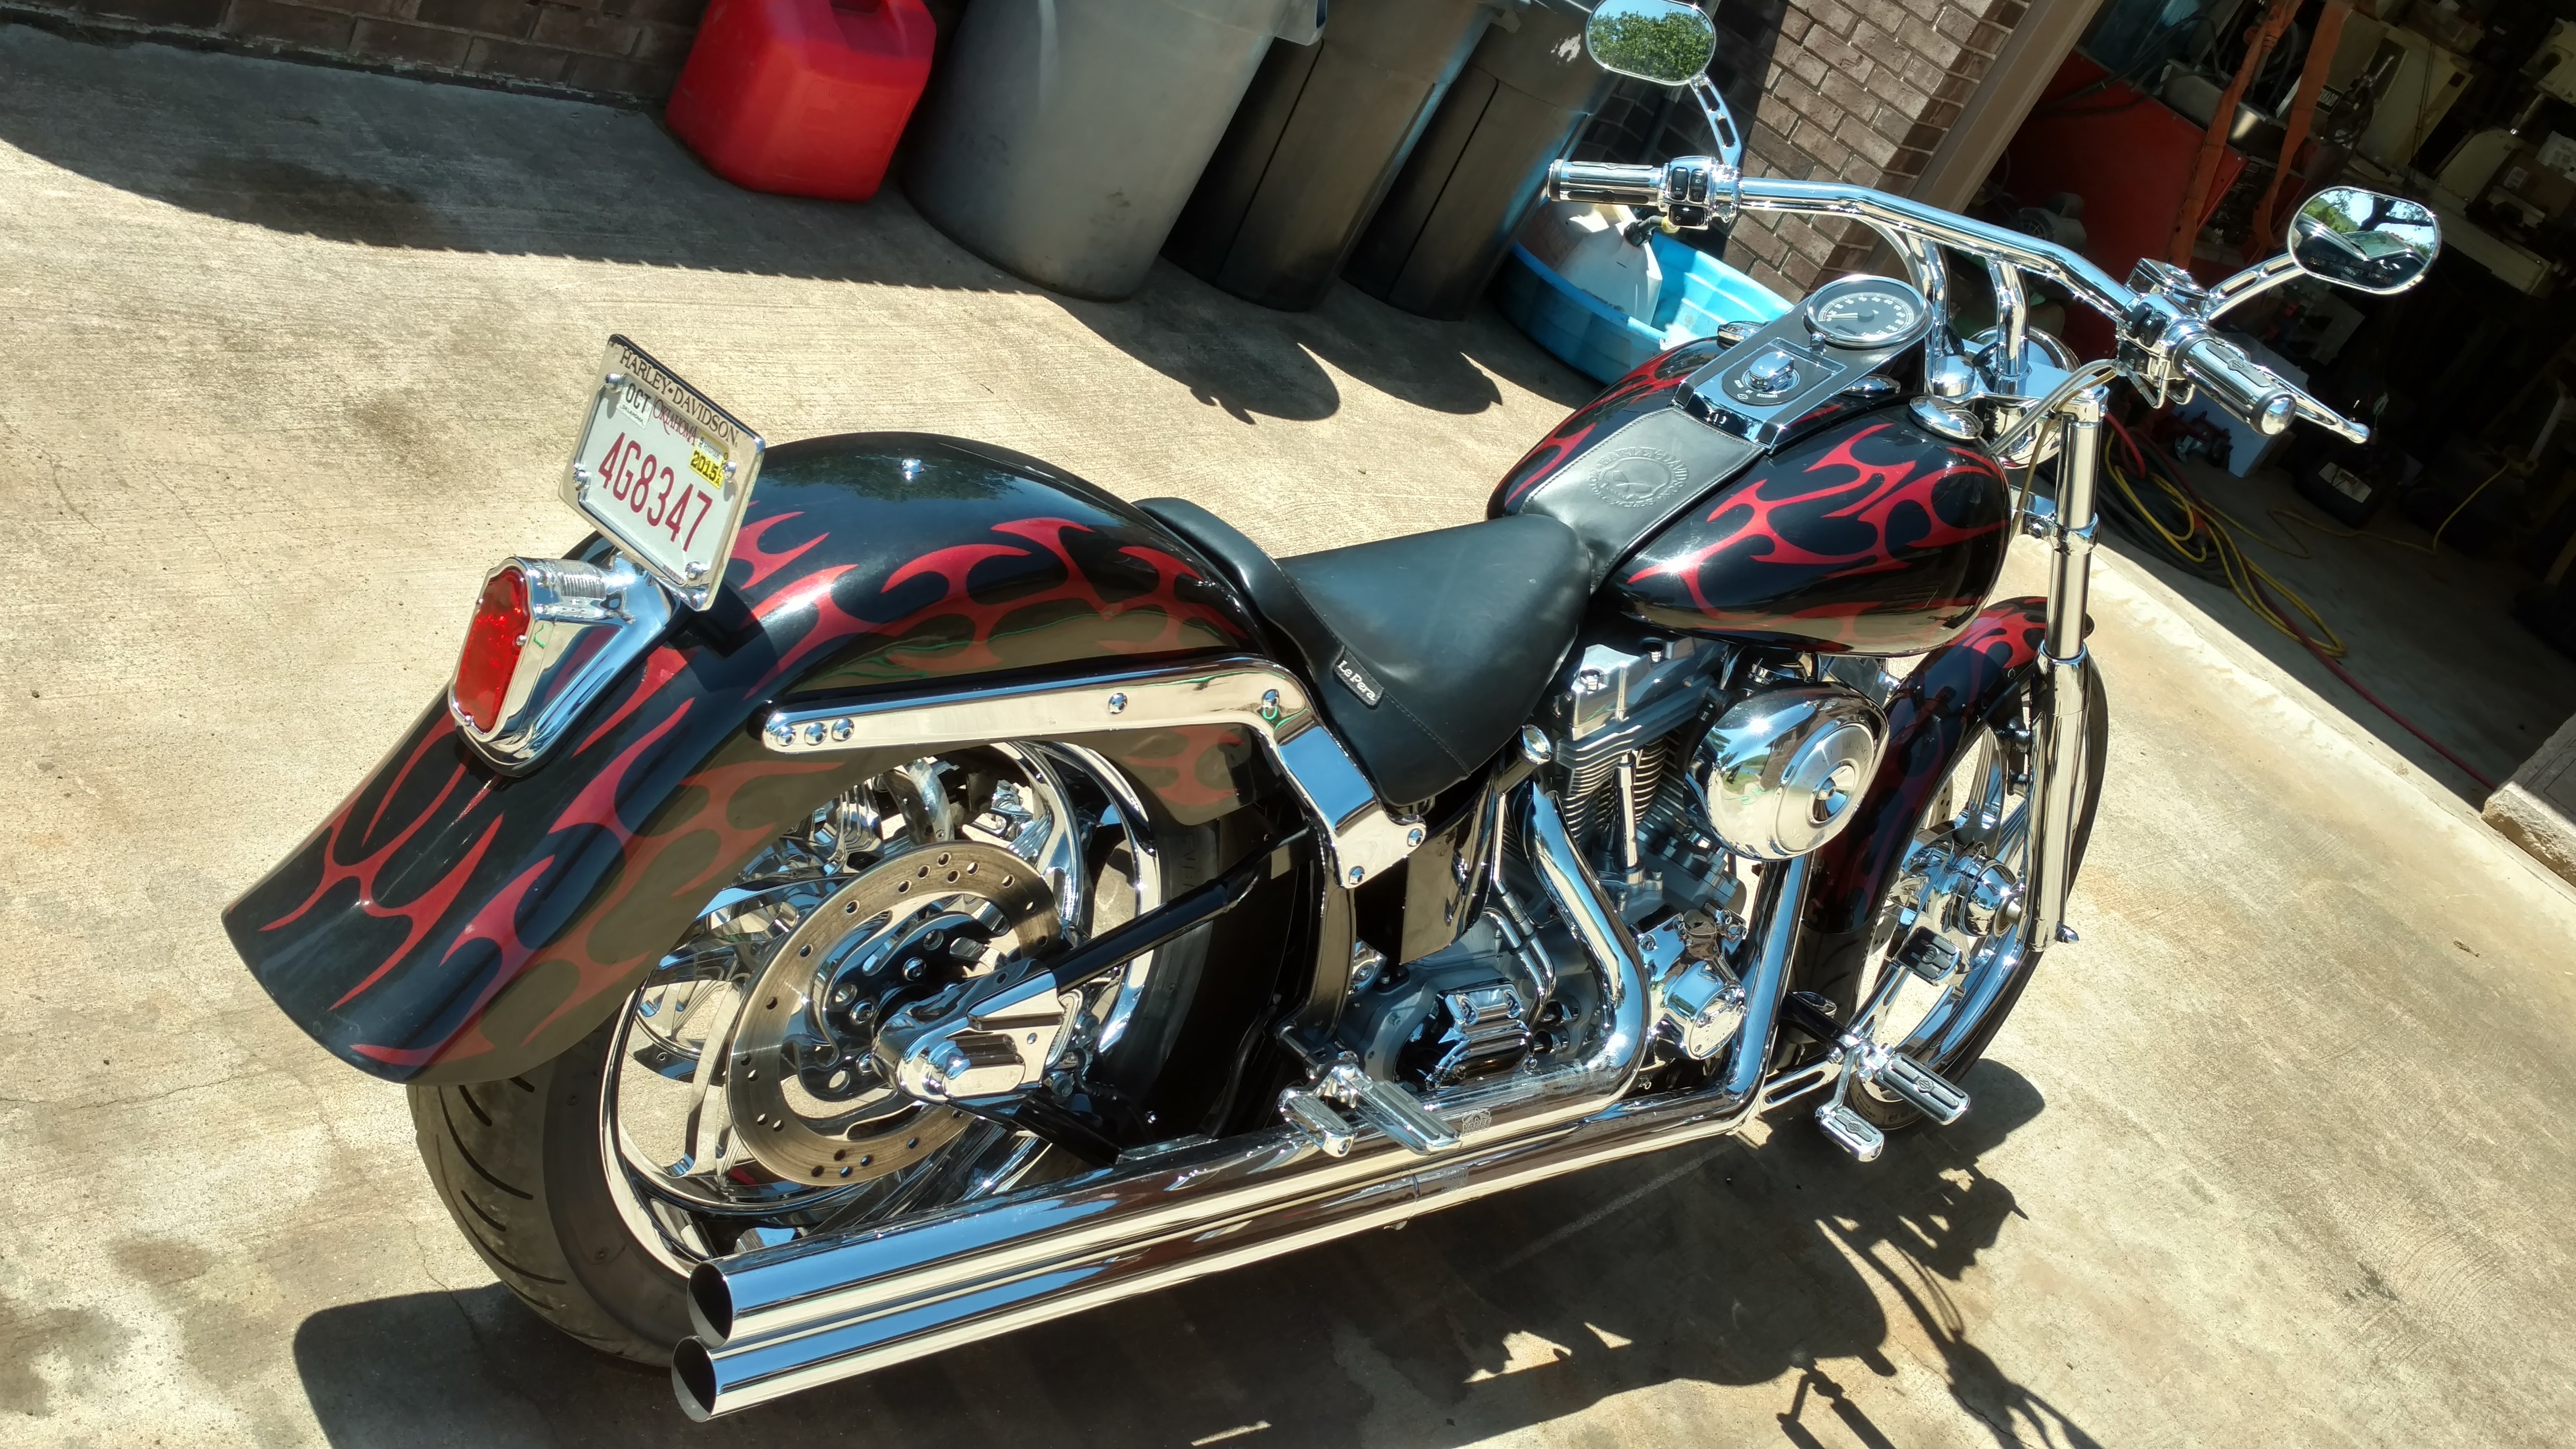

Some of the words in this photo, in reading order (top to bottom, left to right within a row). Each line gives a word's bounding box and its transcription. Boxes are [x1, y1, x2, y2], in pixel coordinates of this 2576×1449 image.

[622, 405, 644, 423] OKLAHOMA
[626, 382, 652, 414] OCT
[653, 399, 698, 446] OKLAHOMA
[690, 450, 719, 481] 2015
[598, 431, 713, 552] 4G8347
[1338, 660, 1353, 677] Le
[1350, 673, 1376, 701] Pera
